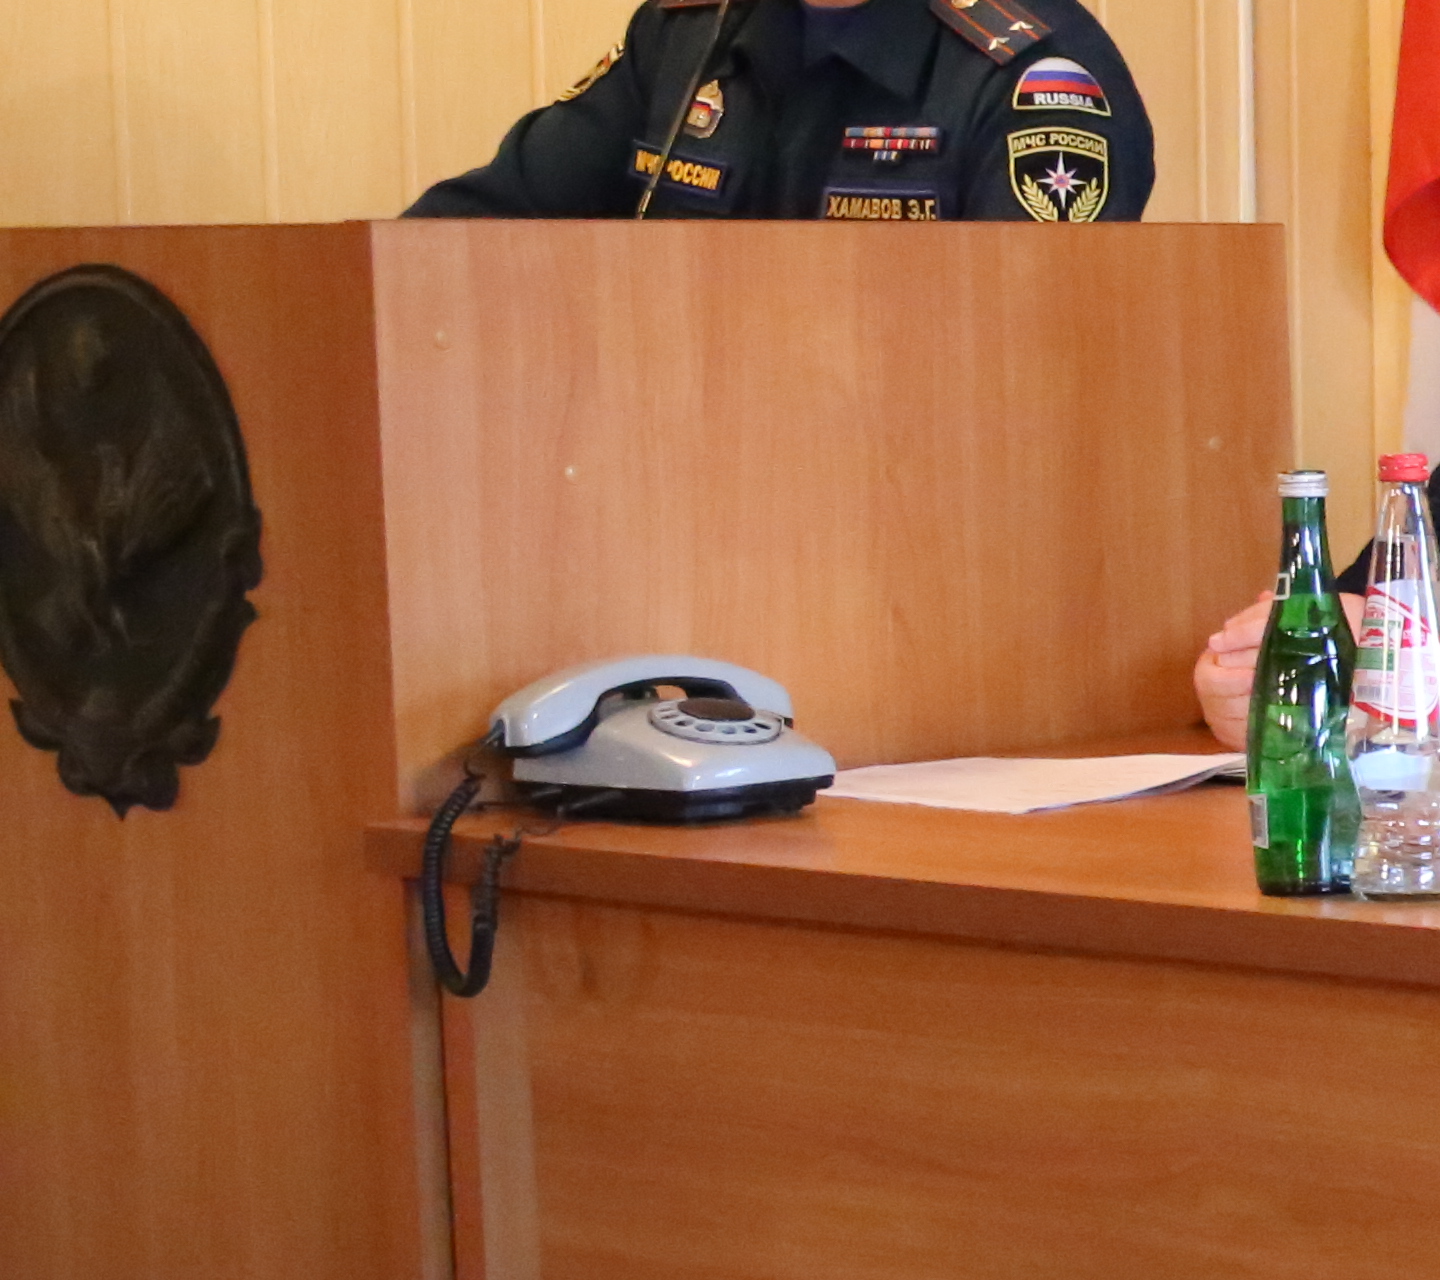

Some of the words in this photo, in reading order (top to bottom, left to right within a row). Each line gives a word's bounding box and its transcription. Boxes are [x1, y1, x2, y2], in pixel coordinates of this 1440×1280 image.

[1032, 92, 1096, 109] RUSSIA
[1013, 133, 1046, 150] МЧС
[1049, 132, 1104, 155] РОССИИ
[907, 199, 937, 220] Э.Г.
